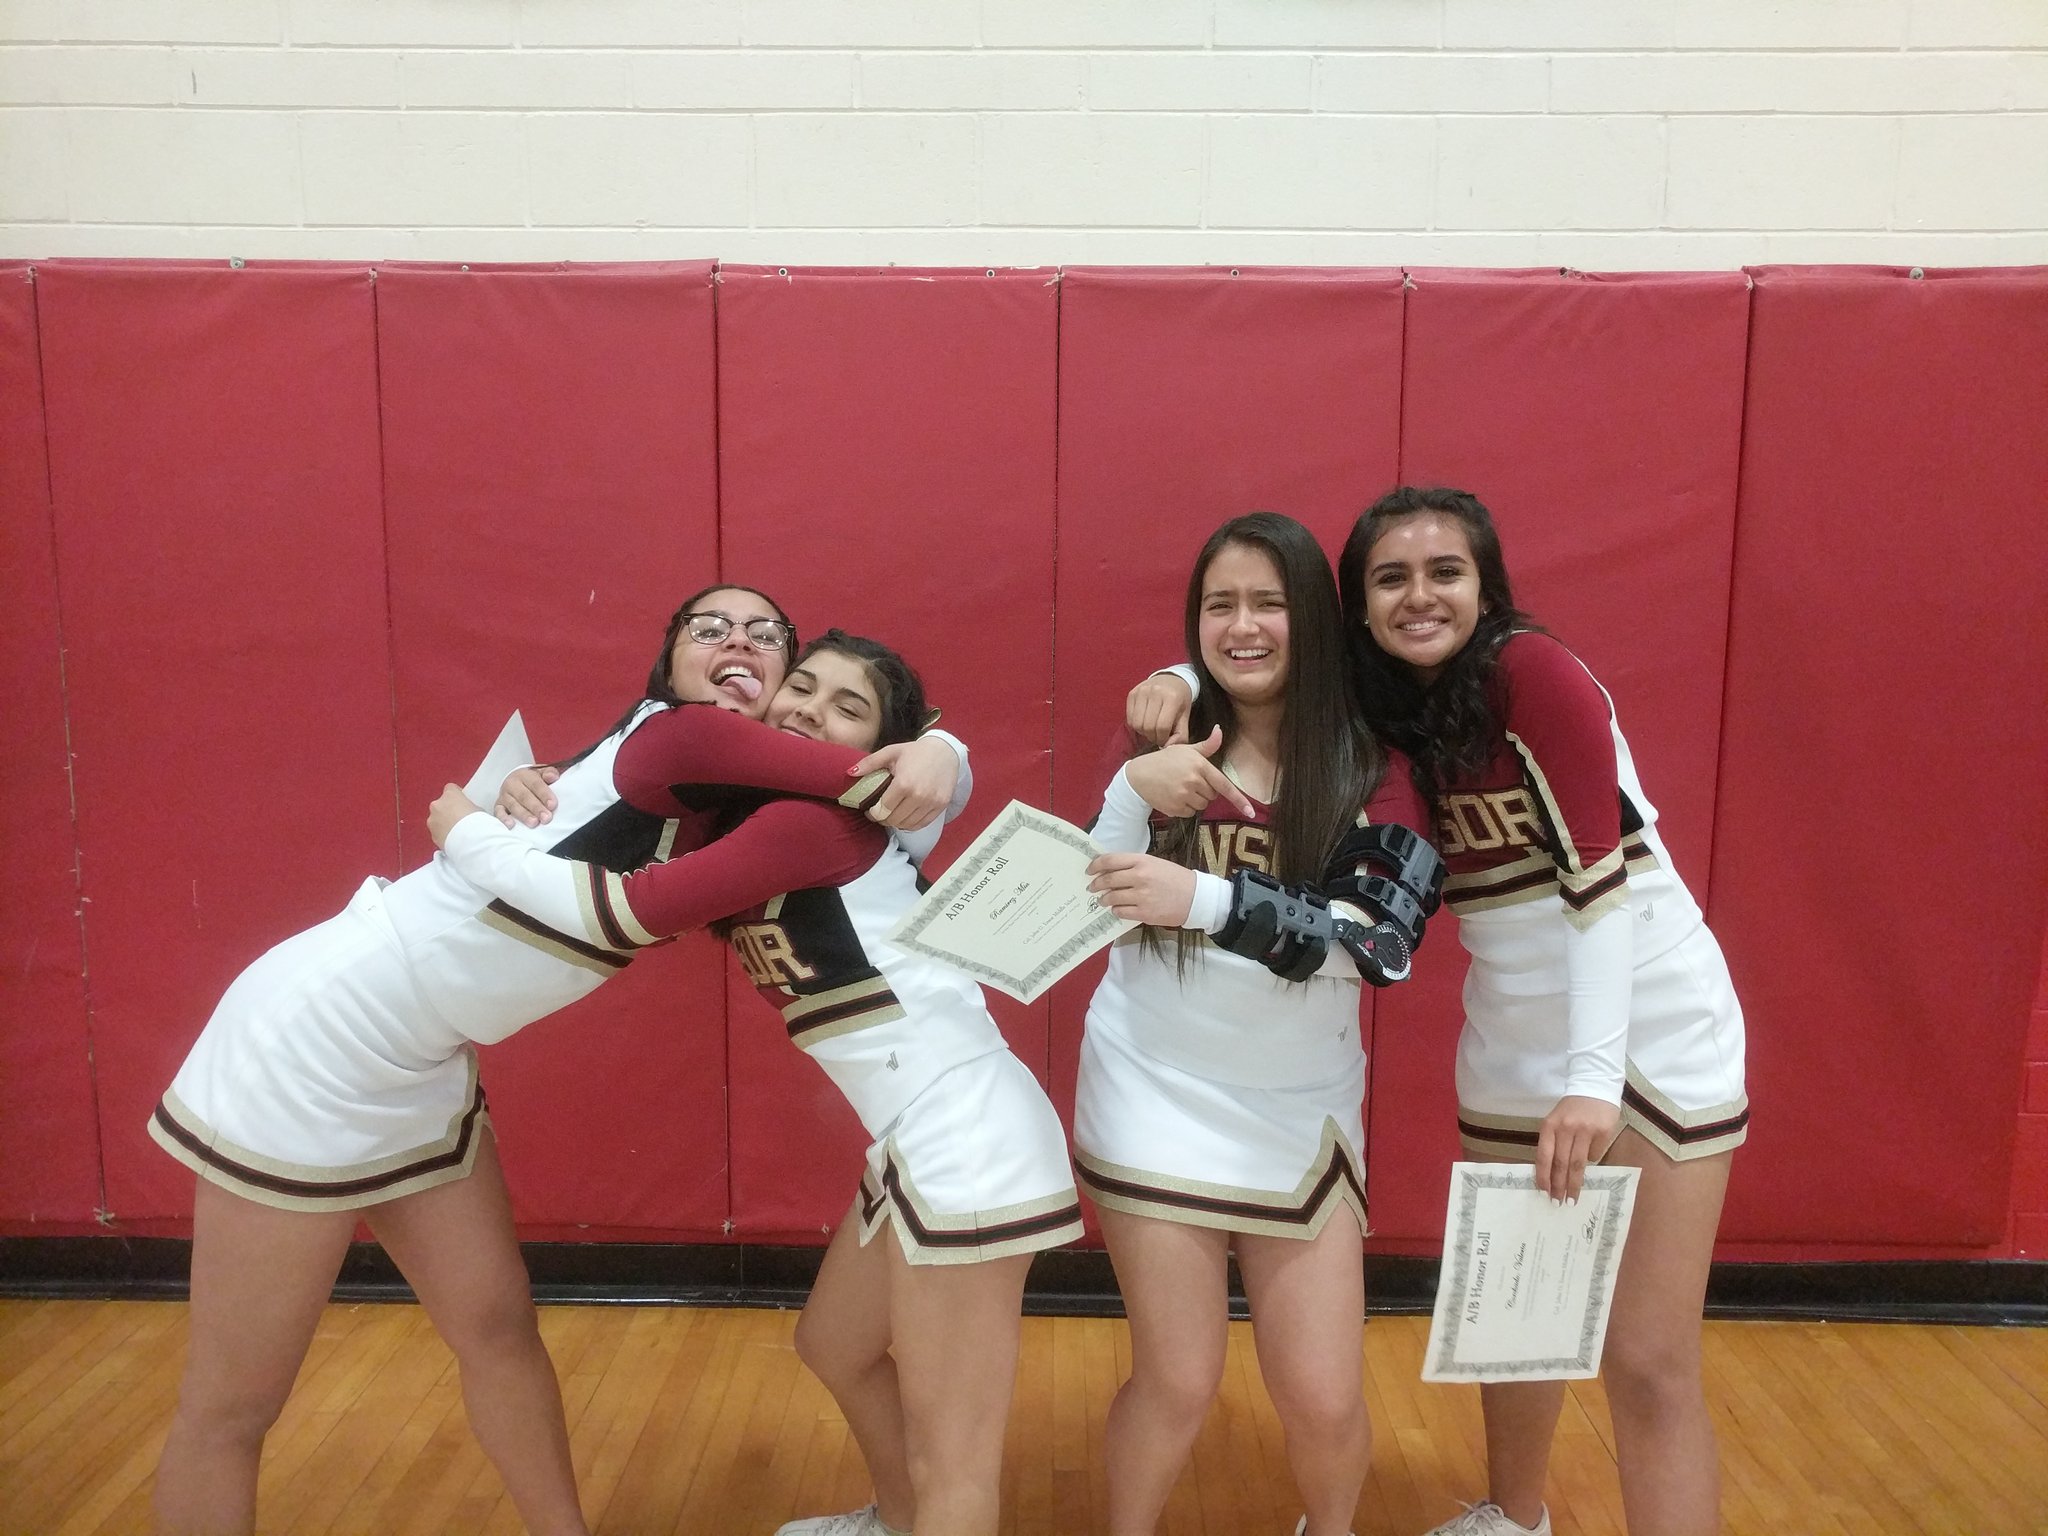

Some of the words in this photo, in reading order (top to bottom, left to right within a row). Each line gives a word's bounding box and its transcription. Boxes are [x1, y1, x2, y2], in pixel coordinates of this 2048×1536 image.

[945, 899, 965, 921] A/B
[961, 874, 990, 903] Honor
[986, 856, 1010, 879] Roll
[1477, 1231, 1491, 1256] Roll
[1470, 1259, 1487, 1298] Honor
[1465, 1301, 1480, 1324] A/B
